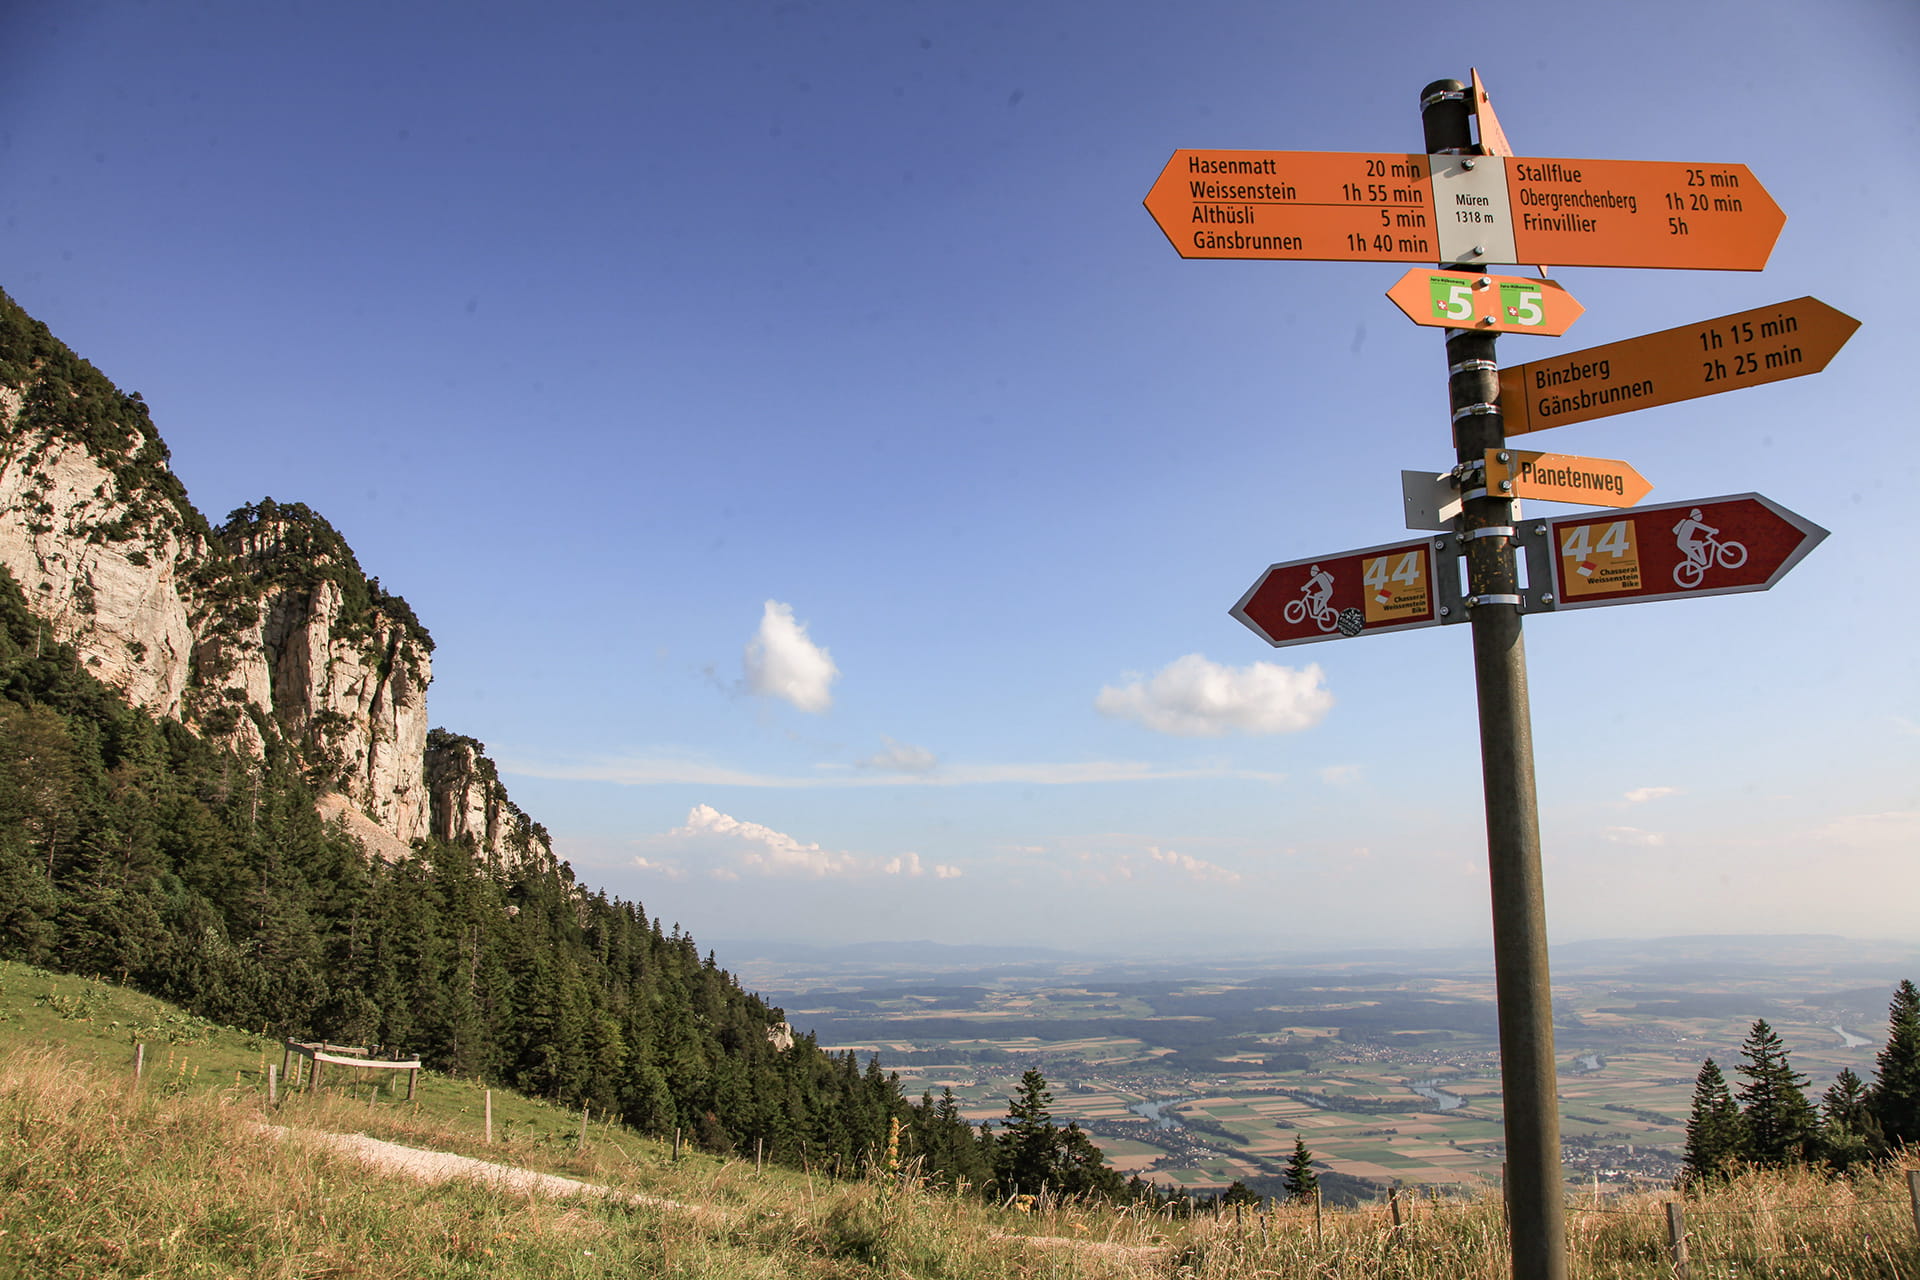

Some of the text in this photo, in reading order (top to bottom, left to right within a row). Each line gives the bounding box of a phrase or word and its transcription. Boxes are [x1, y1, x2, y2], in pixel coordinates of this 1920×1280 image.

[1189, 156, 1420, 178] Hasenmatt 20 min
[1517, 163, 1739, 188] Stallflue 25 min
[1190, 181, 1423, 203] Weissenstein 1h 55 min
[1456, 193, 1489, 207] Müren
[1520, 188, 1743, 213] Obergrenchenberg 1h 20 min
[1192, 205, 1426, 228] Althüsli 5 min
[1456, 211, 1494, 224] 1318 m
[1524, 213, 1689, 235] Frinvillier 5h
[1193, 231, 1428, 253] Gänsbrunnen 1h 40 min
[1447, 286, 1472, 320] 5
[1518, 291, 1542, 326] 5
[1535, 314, 1798, 389] Binzberg 1h 15 min
[1538, 344, 1803, 417] Gänsbrunnen 2h 25 min
[1521, 461, 1624, 495] Planetenweg
[1562, 520, 1630, 562] 44
[1363, 551, 1420, 591] 44
[1587, 573, 1639, 584] Weissenstein
[1600, 566, 1638, 576] Chasseral
[1383, 600, 1426, 611] Weissenstein
[1394, 593, 1426, 603] Chasseral
